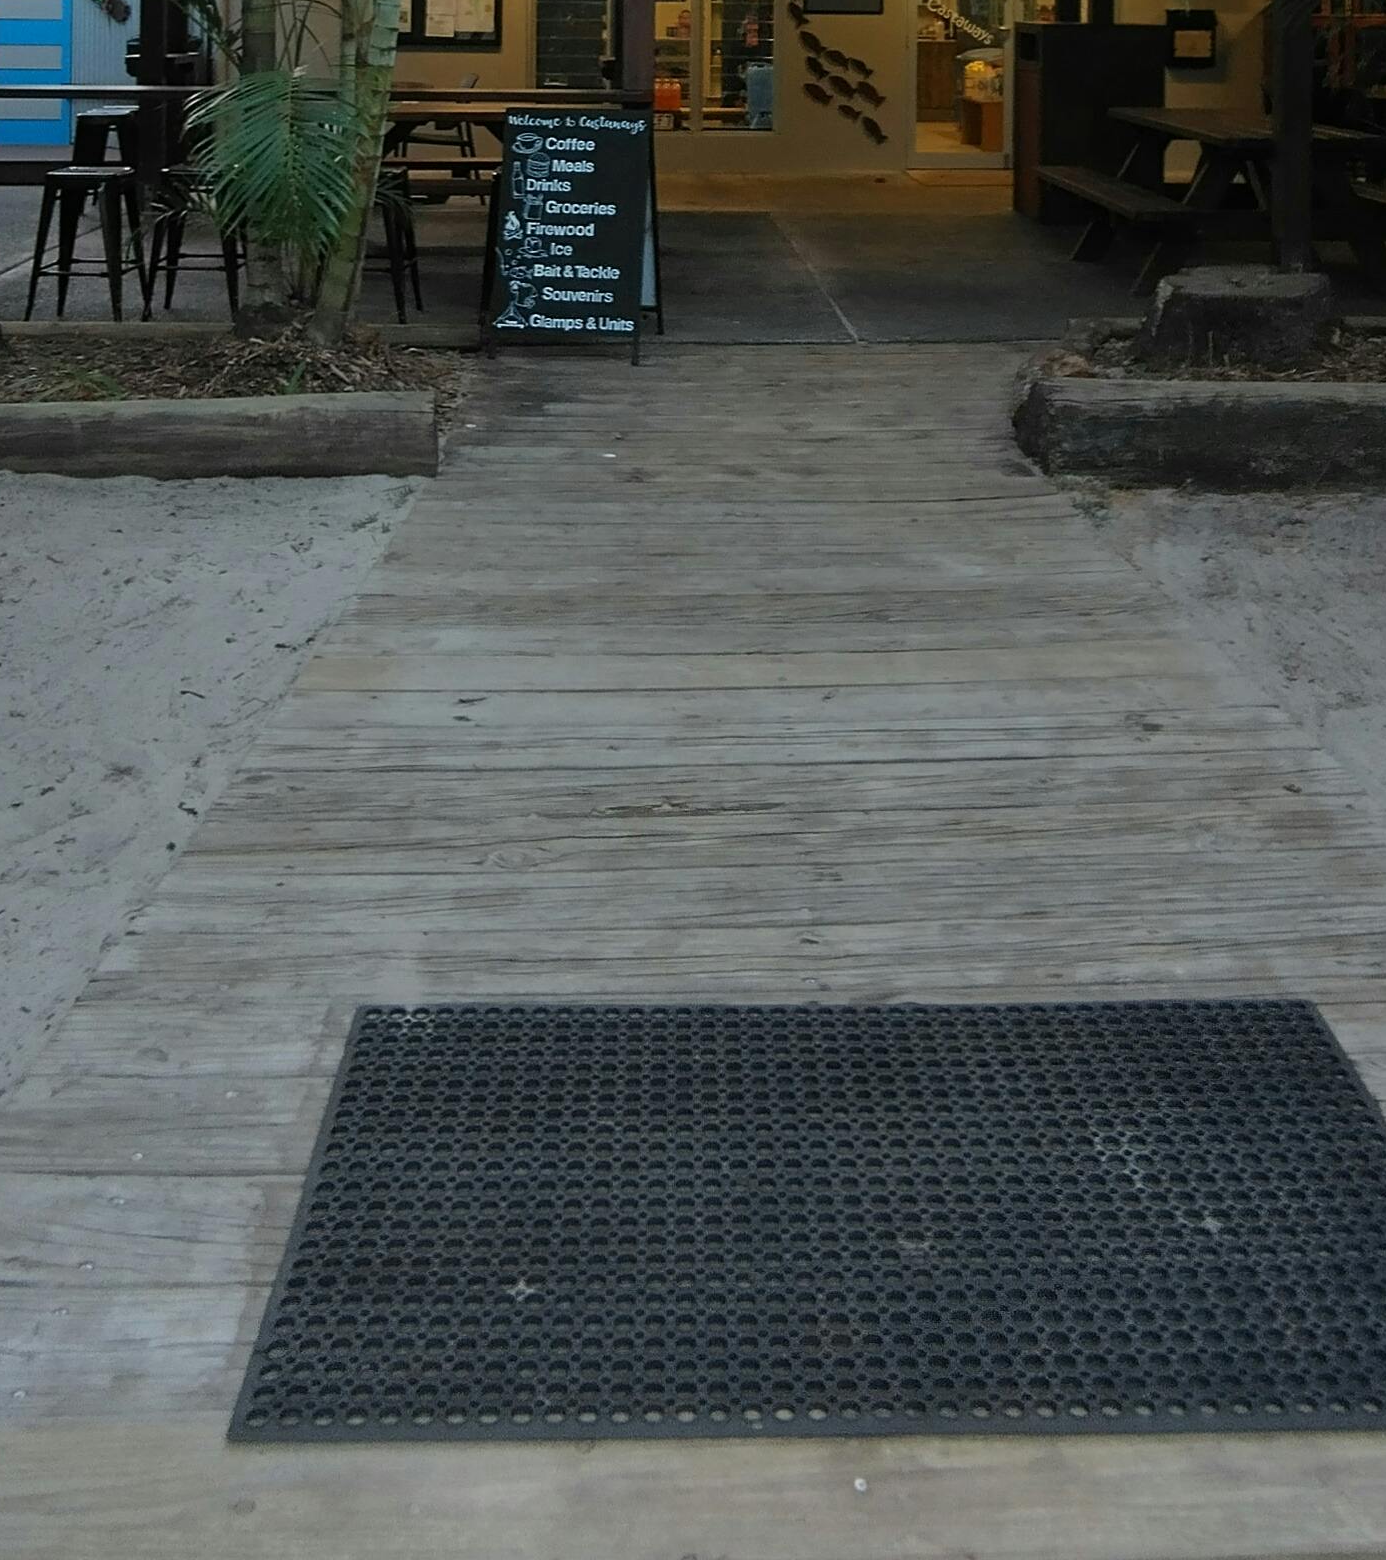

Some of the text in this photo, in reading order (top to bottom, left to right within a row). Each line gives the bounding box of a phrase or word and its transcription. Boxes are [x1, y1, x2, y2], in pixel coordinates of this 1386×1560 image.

[508, 114, 562, 129] Welcome
[565, 116, 576, 127] to
[545, 137, 596, 151] Coffee
[552, 159, 595, 173] Meals
[525, 178, 571, 192] Drinks
[545, 200, 617, 215] Groceries
[526, 222, 595, 237] Firewood
[550, 243, 573, 256] Ice
[533, 264, 621, 279] Bait & Tackle
[542, 287, 614, 303] Souvenirs
[529, 314, 635, 331] Glamps & Units
